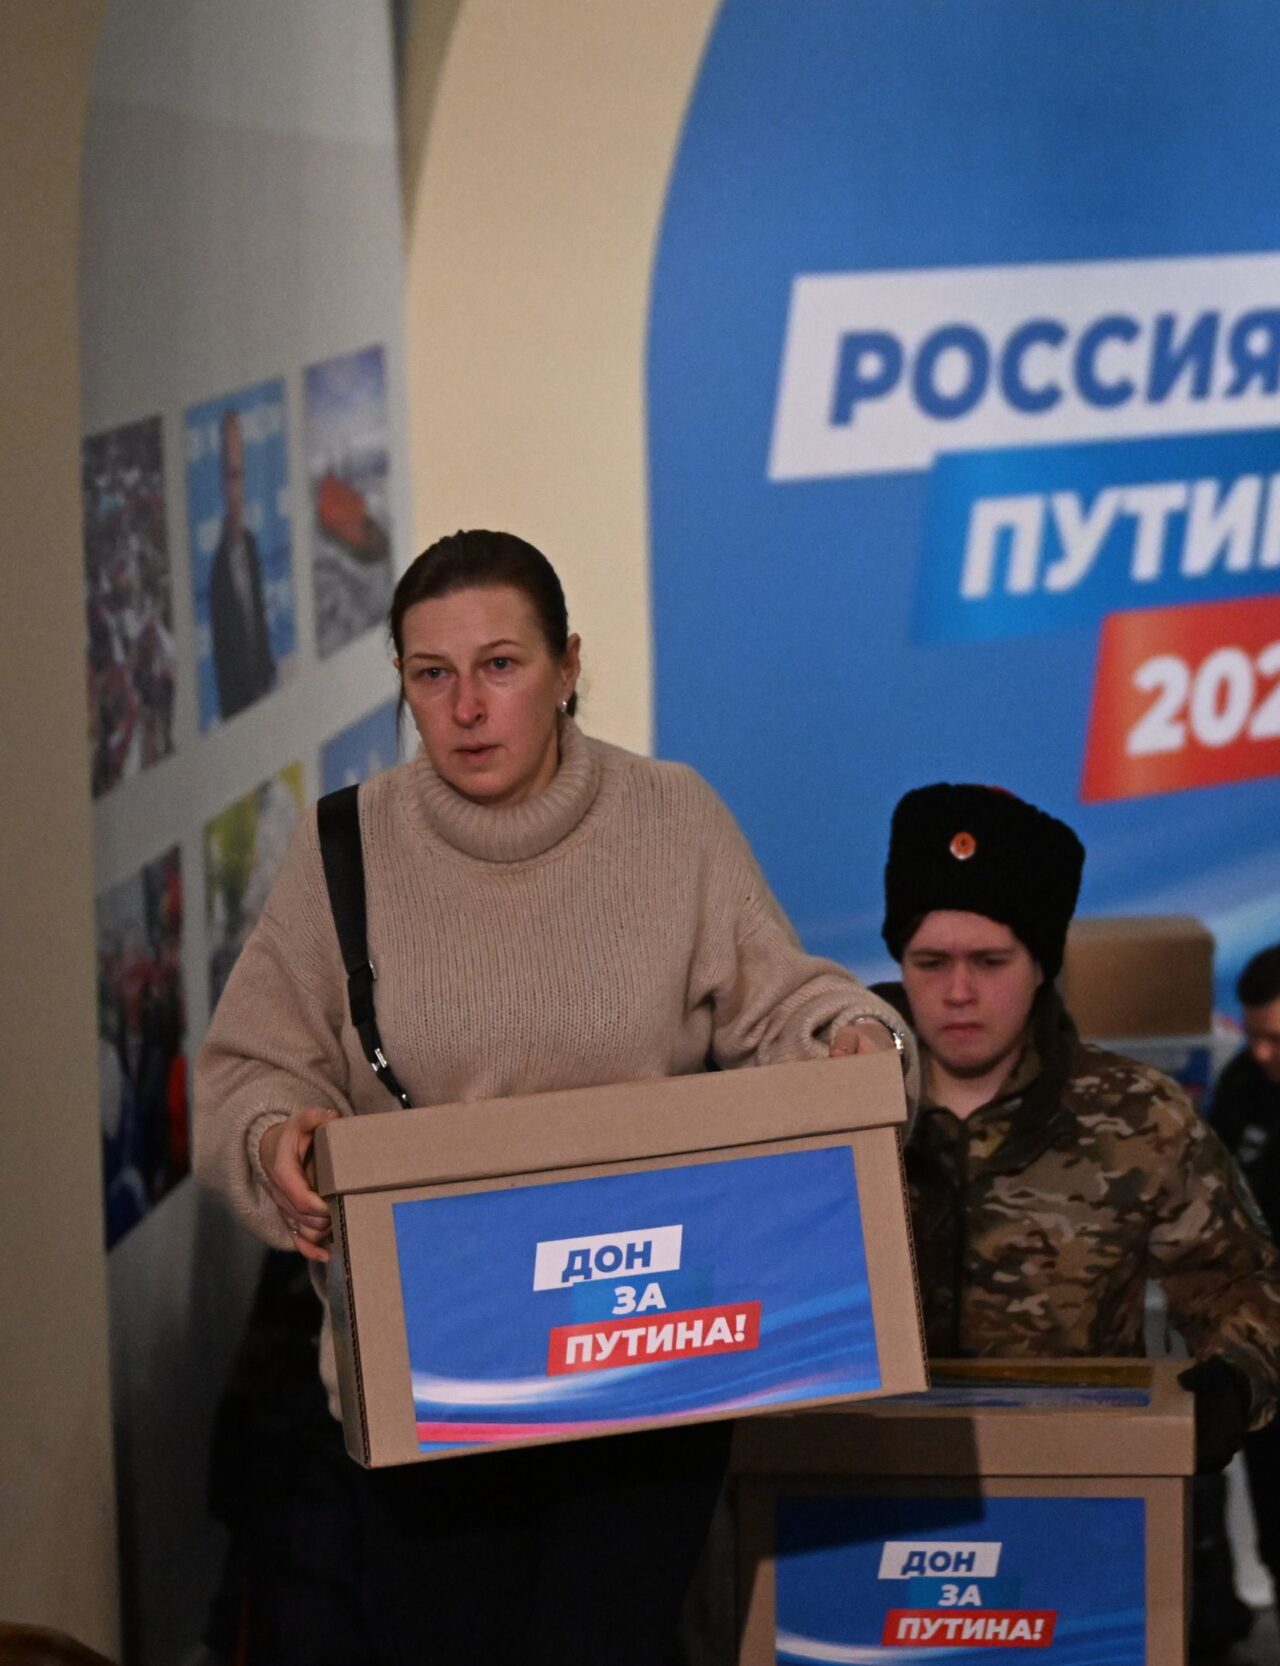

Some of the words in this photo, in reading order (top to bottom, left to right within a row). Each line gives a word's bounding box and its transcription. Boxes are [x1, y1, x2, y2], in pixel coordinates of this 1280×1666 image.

[561, 1240, 652, 1283] ДОН
[612, 1282, 667, 1315] ЗА
[565, 1314, 746, 1365] ПУТИНА!
[901, 1551, 976, 1576] ДОН
[937, 1584, 982, 1607] ЗА
[896, 1617, 1045, 1641] ПУТИНА!
